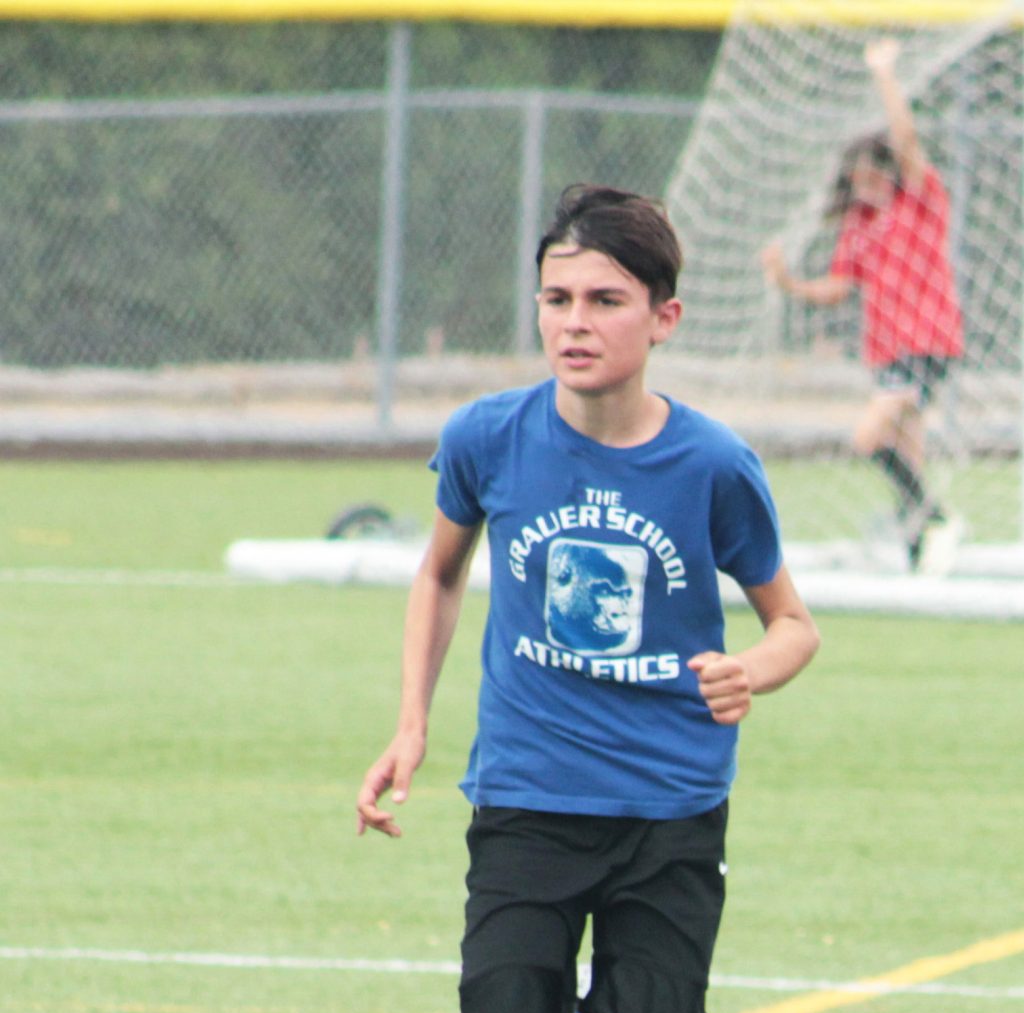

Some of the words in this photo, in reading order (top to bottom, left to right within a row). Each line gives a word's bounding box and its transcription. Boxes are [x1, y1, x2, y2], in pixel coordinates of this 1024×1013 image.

[585, 487, 622, 506] THE
[509, 505, 601, 583] GRAUER
[606, 507, 687, 596] SCHOOL
